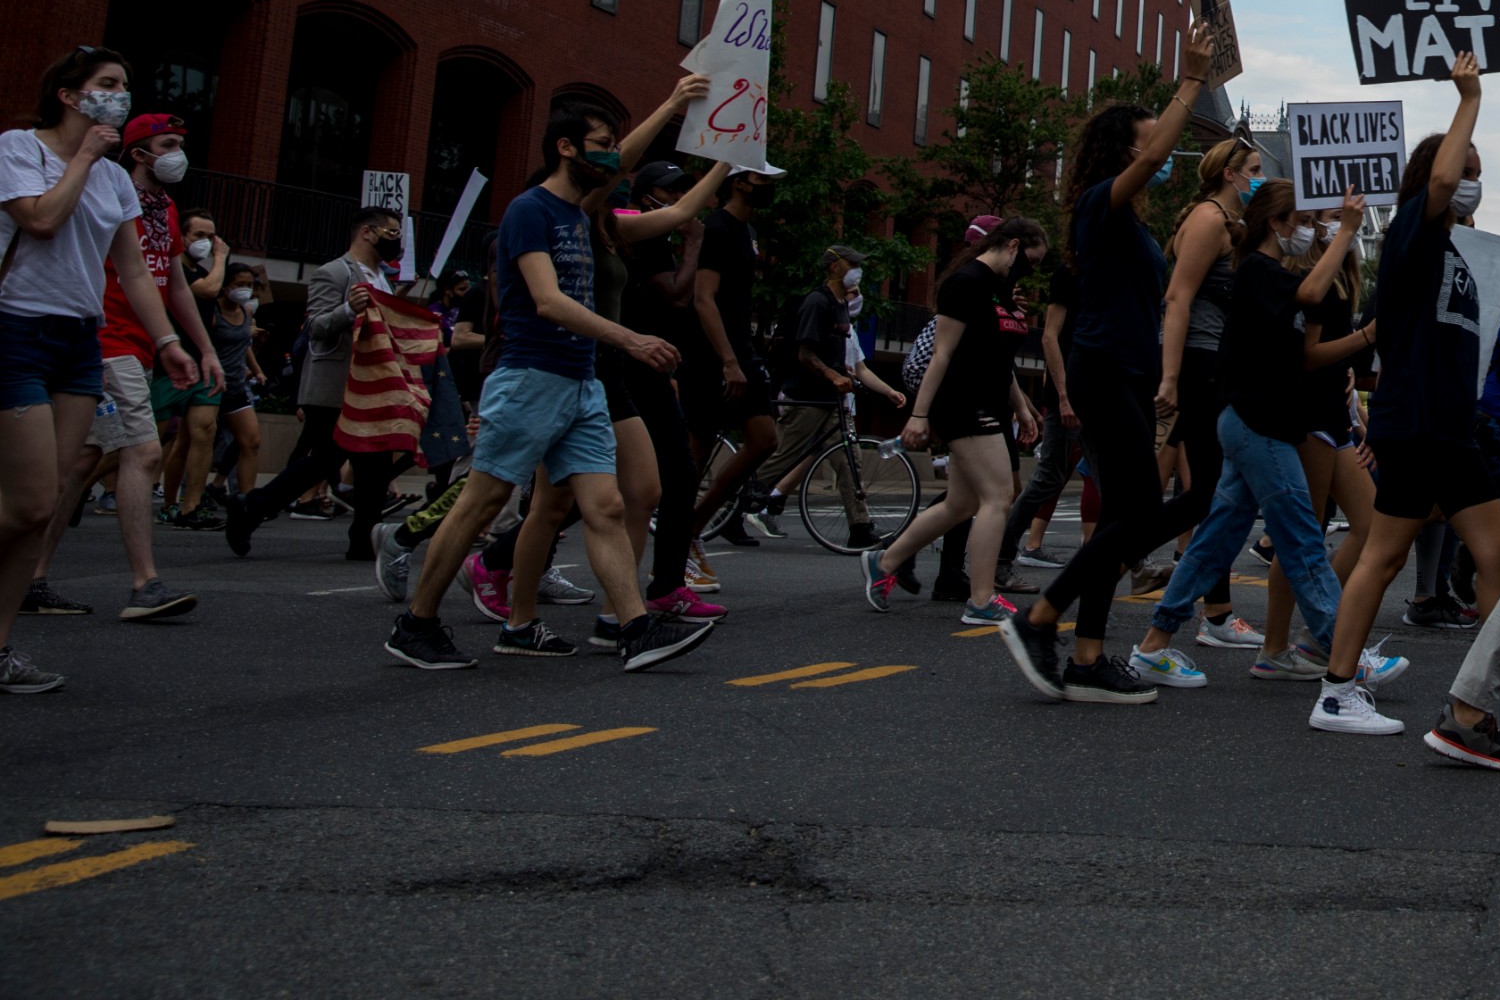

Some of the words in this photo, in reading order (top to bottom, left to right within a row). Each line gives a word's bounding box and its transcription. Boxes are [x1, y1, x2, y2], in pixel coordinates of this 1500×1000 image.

[1297, 113, 1351, 146] BLACK
[1355, 111, 1399, 143] LIVES
[369, 172, 405, 194] BLACK
[1310, 157, 1393, 195] MATTER
[368, 192, 404, 213] LIVES
[478, 582, 497, 596] N
[671, 600, 692, 614] N
